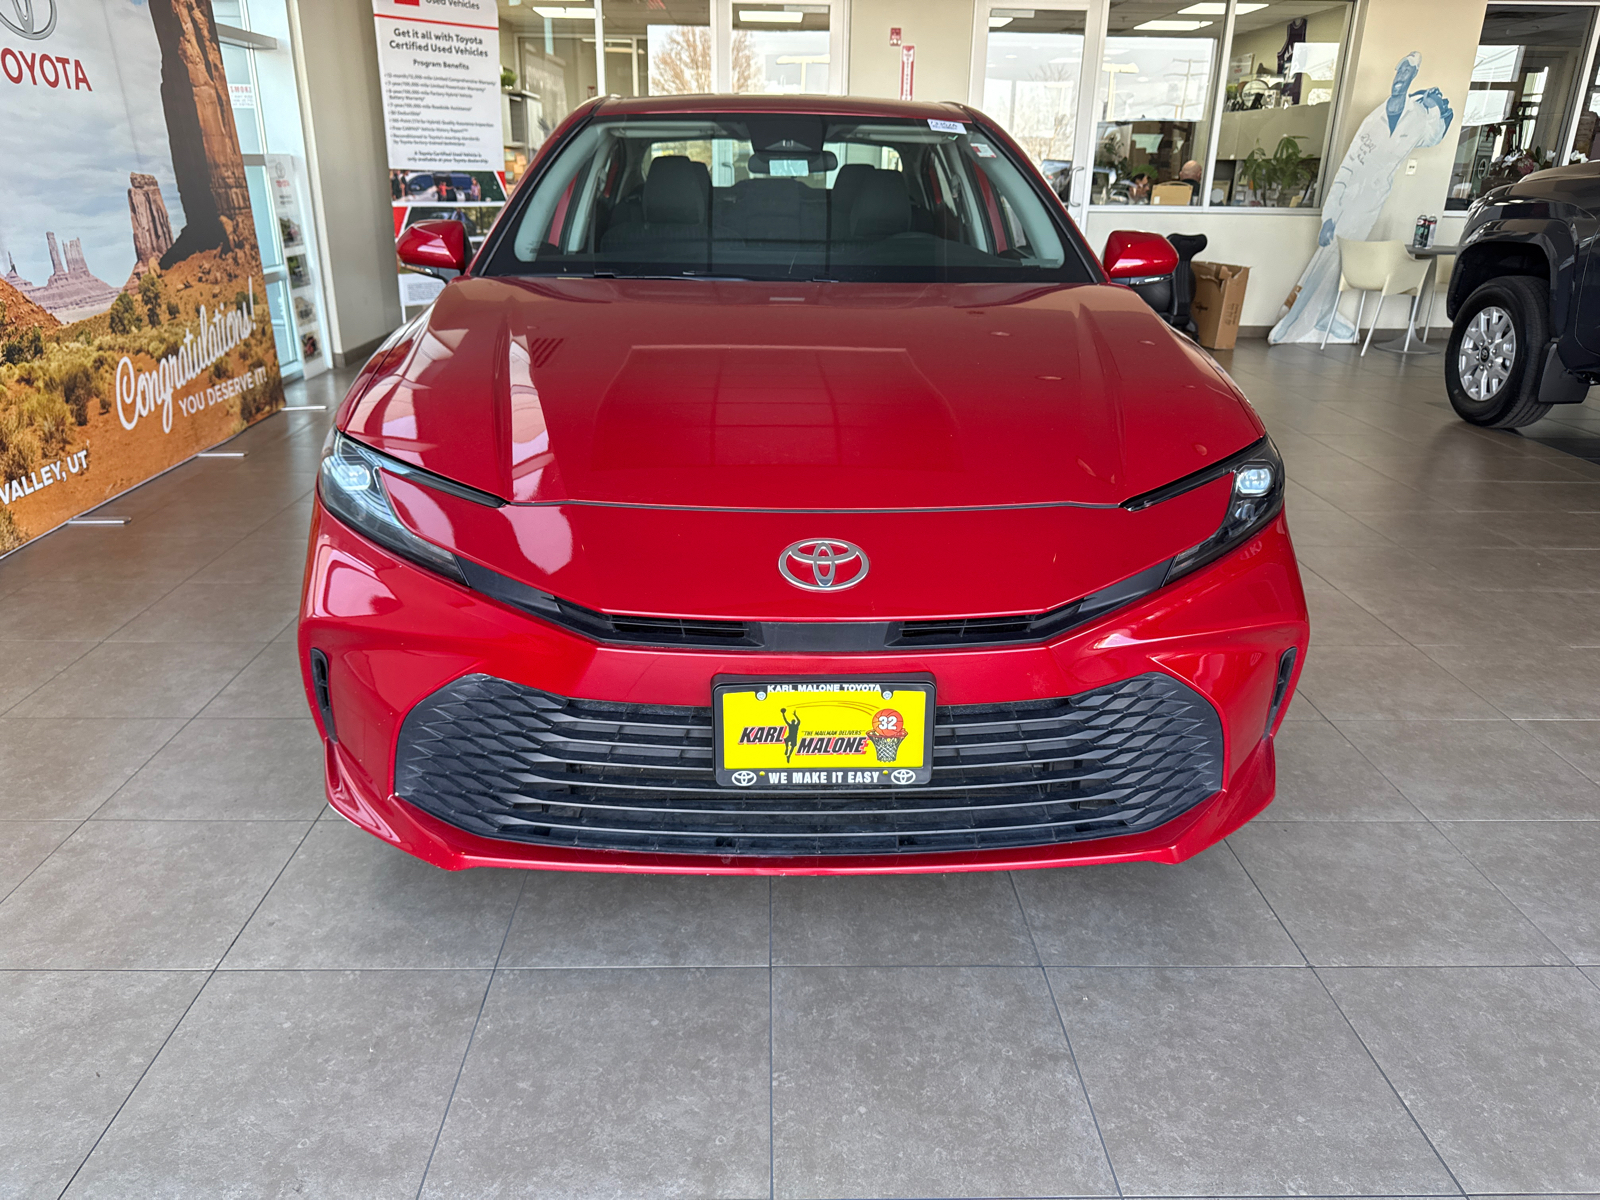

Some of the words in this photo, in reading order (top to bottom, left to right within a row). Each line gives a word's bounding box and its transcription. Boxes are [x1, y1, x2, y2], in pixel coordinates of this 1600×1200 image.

[447, 0, 480, 10] Vehicles
[394, 28, 410, 38] Get
[412, 30, 419, 38] it
[421, 32, 432, 40] all
[434, 32, 454, 41] with
[455, 34, 483, 46] Toyota
[390, 40, 429, 51] Certified
[431, 43, 452, 54] Used
[454, 46, 488, 57] Vehicles
[1, 47, 93, 92] OYOTA
[413, 59, 442, 69] Program
[443, 62, 469, 70] Benefits
[115, 276, 257, 433] Congratulations!
[178, 391, 205, 417] YOU
[206, 371, 255, 406] DESERVE
[254, 366, 268, 384] IT!
[0, 460, 67, 505] VALLEY,
[66, 449, 87, 474] UT
[798, 684, 840, 692] MALONE
[843, 684, 881, 692] TOYOTA
[879, 715, 897, 730] 32
[738, 726, 786, 745] KARL
[796, 736, 868, 755] MALONE
[769, 772, 788, 784] WE
[792, 772, 828, 783] MAKE
[832, 772, 842, 783] IT
[847, 771, 880, 783] EASY
